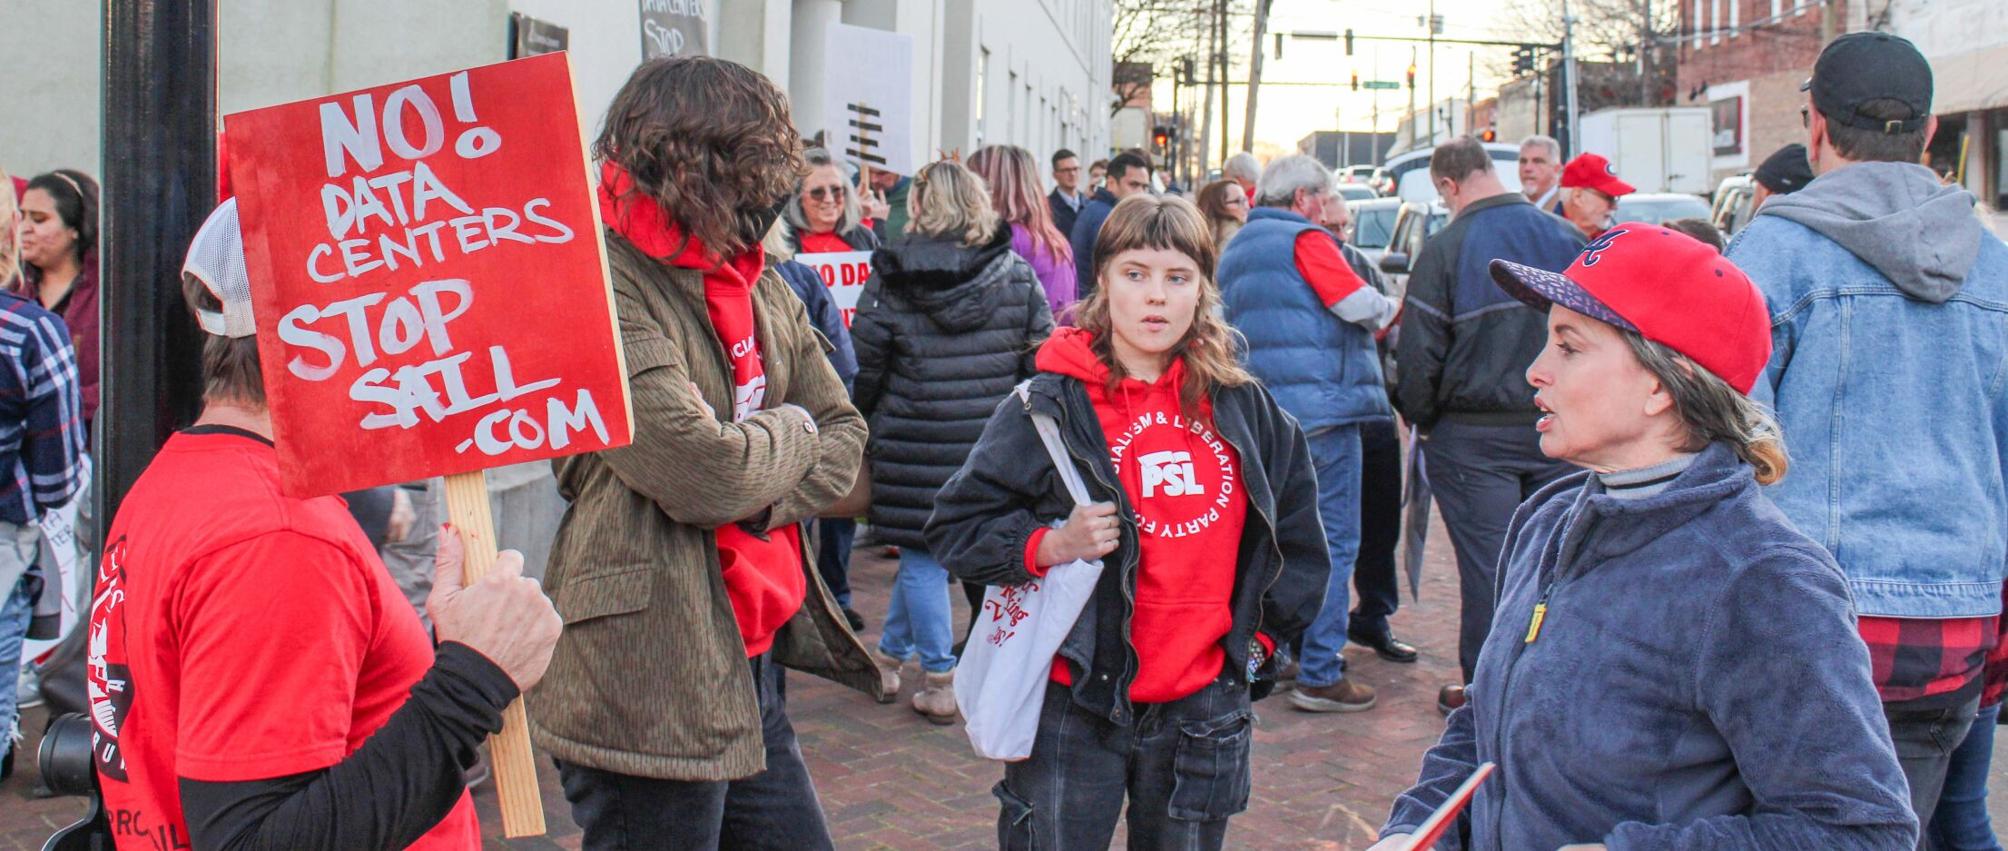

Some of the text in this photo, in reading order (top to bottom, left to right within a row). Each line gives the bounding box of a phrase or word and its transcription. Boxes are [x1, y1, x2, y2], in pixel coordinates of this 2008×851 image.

[644, 19, 684, 54] STOP
[319, 71, 501, 177] NO!
[307, 198, 575, 283] CENTERS
[321, 161, 474, 241] DATA
[811, 263, 835, 287] O
[277, 279, 474, 381] STOP
[349, 345, 561, 429] SAIL
[1156, 411, 1169, 425] &
[1138, 451, 1205, 498] PSL
[1173, 415, 1235, 509] LBERATION
[1160, 507, 1220, 538] PARTY
